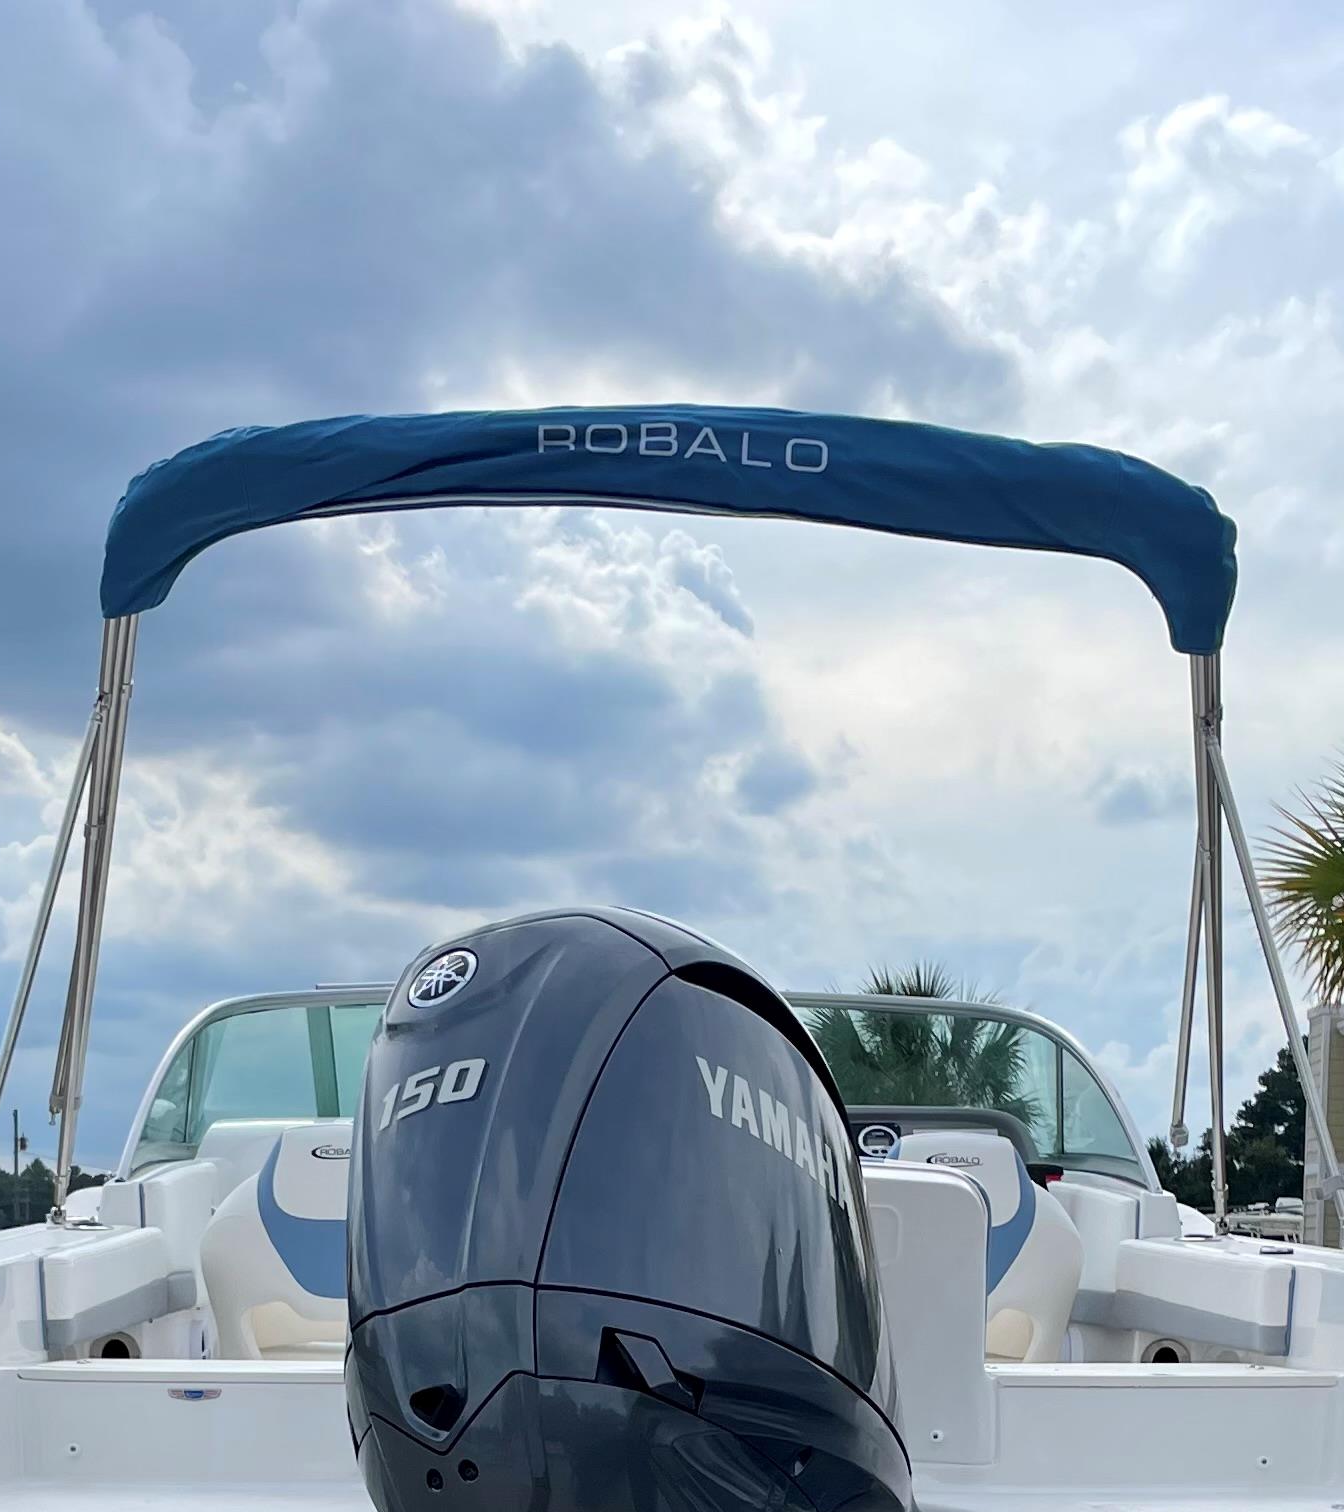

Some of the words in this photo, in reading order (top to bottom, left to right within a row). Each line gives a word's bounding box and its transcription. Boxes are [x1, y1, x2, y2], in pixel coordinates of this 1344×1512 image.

[537, 422, 829, 474] ROBALO
[378, 1058, 486, 1131] 150
[695, 1055, 856, 1216] YAMAHA
[934, 1155, 981, 1166] ROBALO
